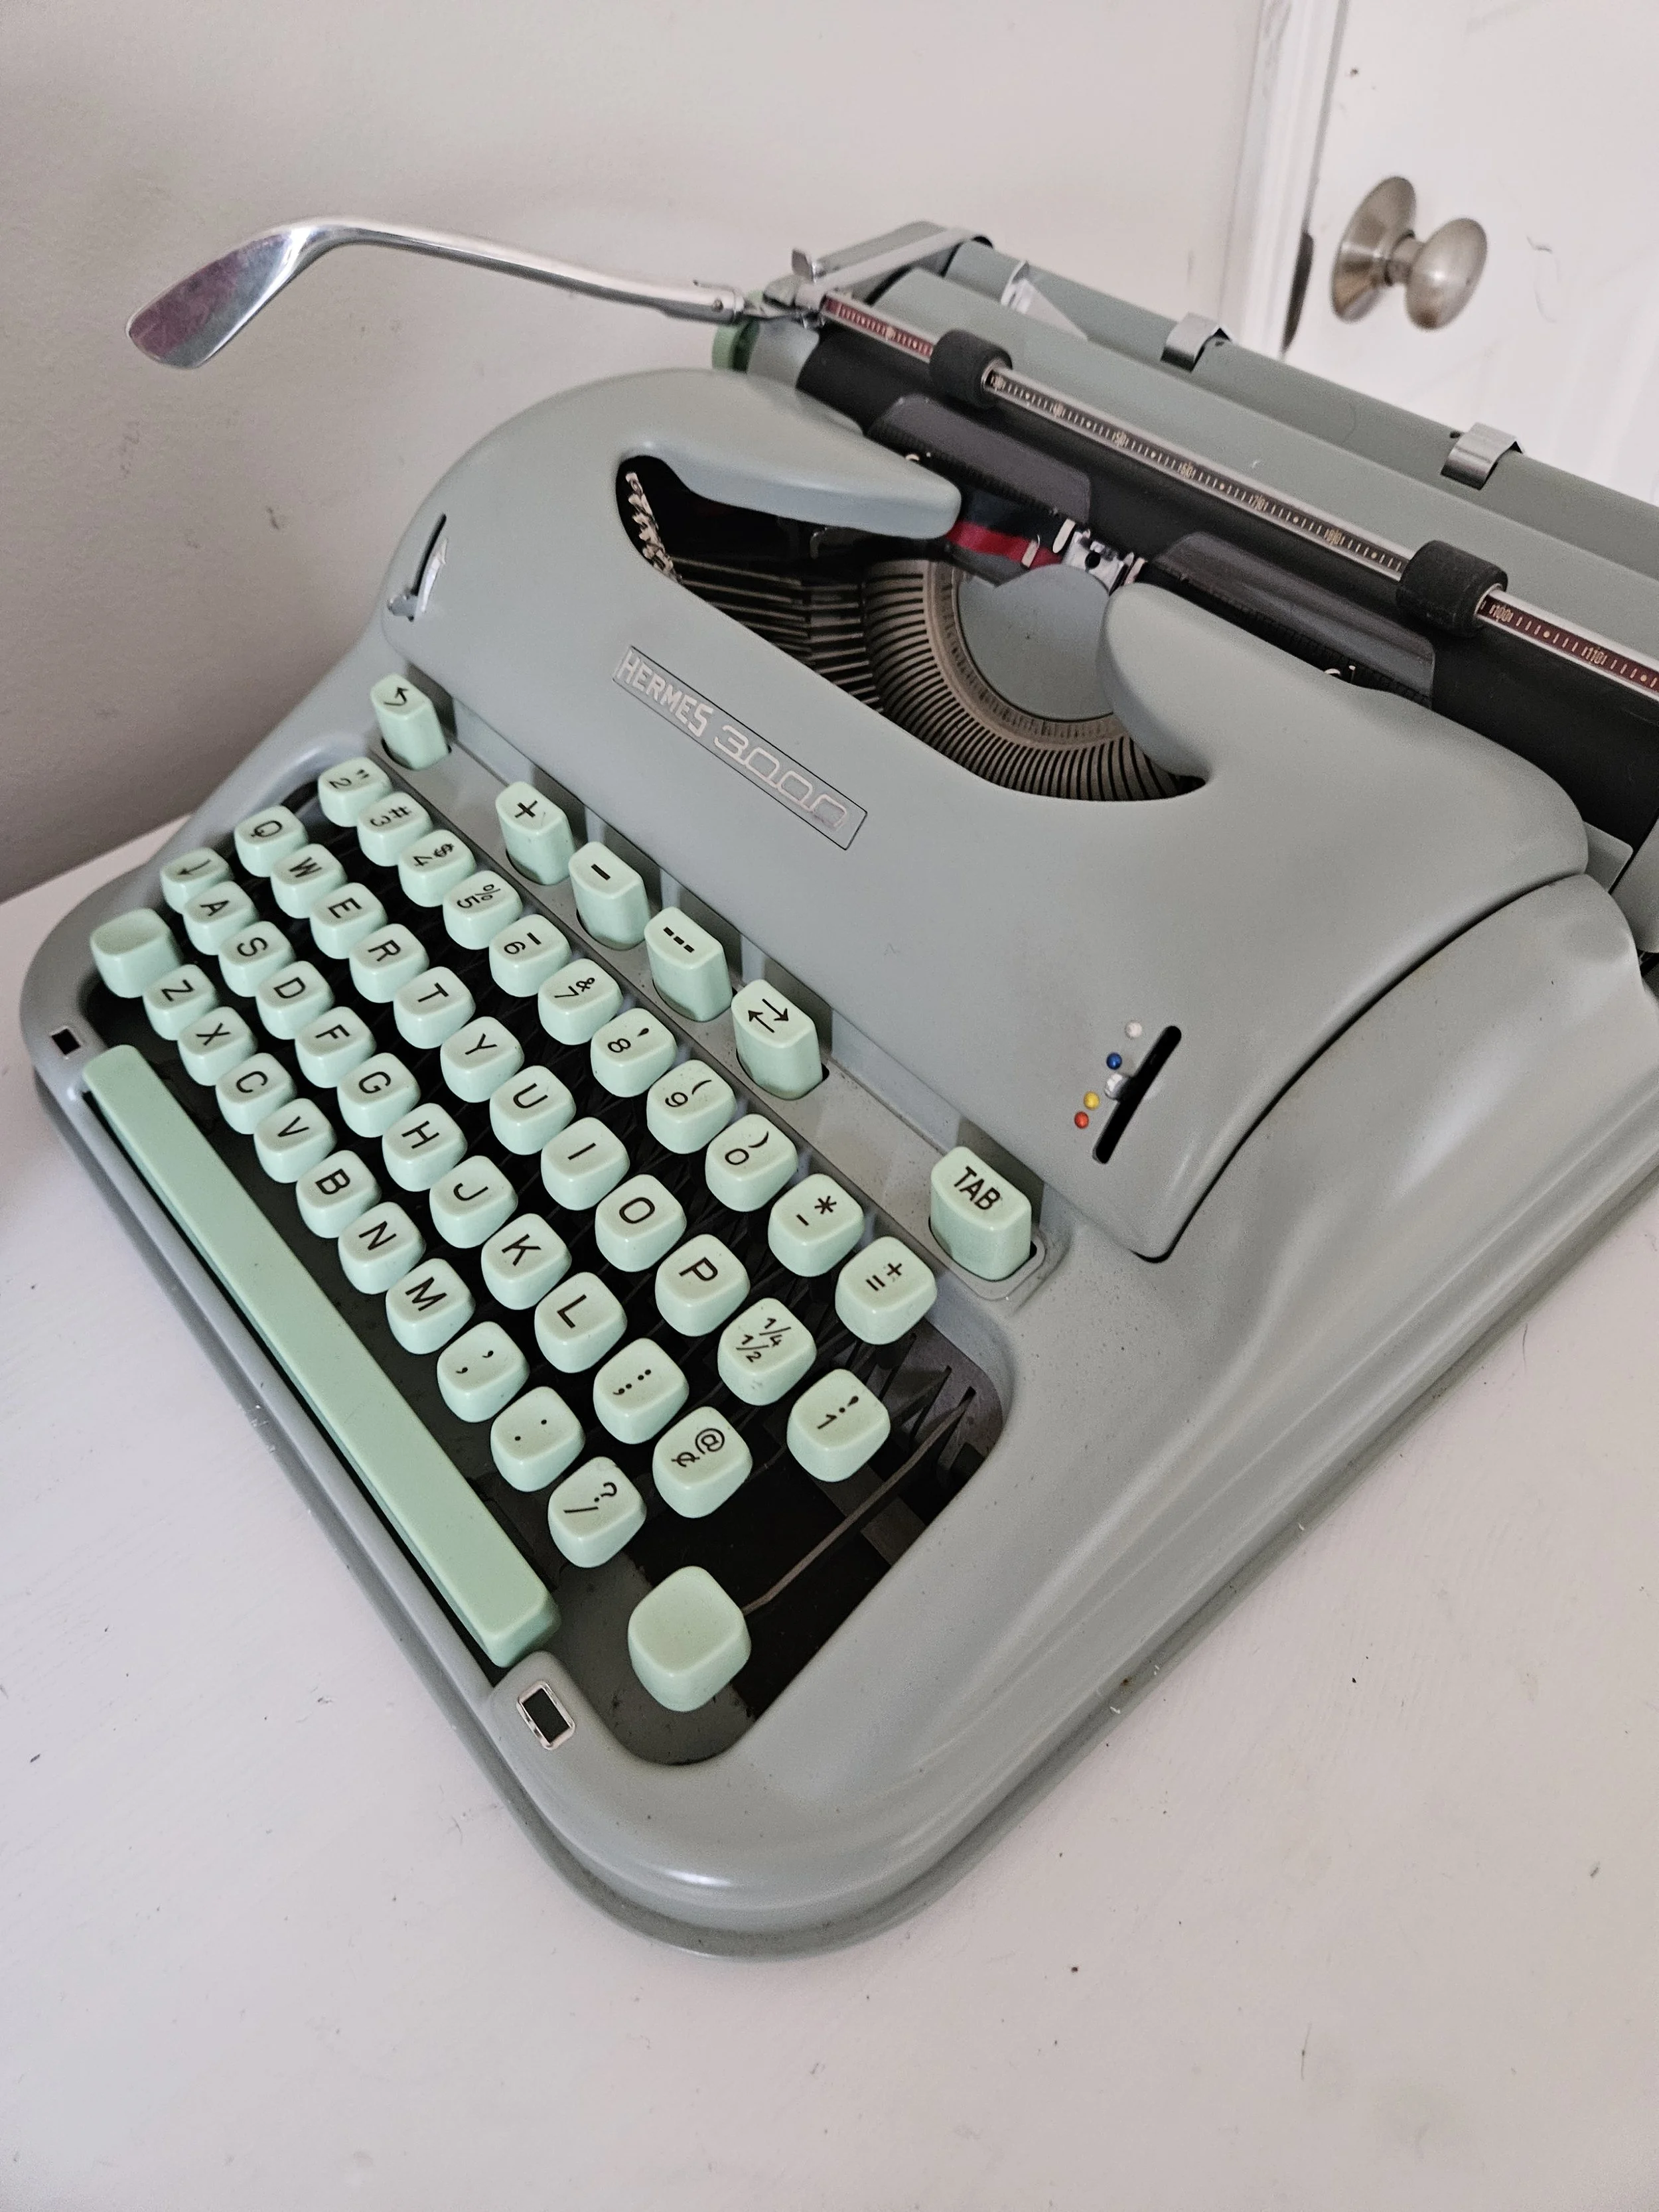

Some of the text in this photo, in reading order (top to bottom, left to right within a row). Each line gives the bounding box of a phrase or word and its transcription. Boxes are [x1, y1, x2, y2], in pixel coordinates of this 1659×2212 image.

[616, 650, 847, 828] HERMES 3000
[328, 778, 352, 789] 2
[250, 820, 283, 838] Q
[370, 813, 390, 827] 3
[413, 855, 433, 867] 4
[433, 843, 454, 857] $
[289, 857, 323, 879] W
[456, 894, 479, 909] 5
[481, 884, 501, 901] %
[199, 900, 230, 917] A
[327, 897, 362, 919] E
[236, 937, 269, 957] S
[367, 939, 401, 962] R
[504, 941, 526, 955] 6
[161, 979, 194, 1002] Z
[273, 976, 307, 999] D
[417, 982, 449, 1003] T
[554, 986, 578, 999] 7
[577, 977, 595, 991] &
[196, 1022, 231, 1047] X
[315, 1024, 350, 1039] F
[465, 1033, 498, 1056] Y
[607, 1038, 632, 1053] 8
[236, 1070, 268, 1094] C
[358, 1071, 392, 1094] G
[512, 1082, 549, 1109] U
[664, 1092, 689, 1108] 9
[277, 1116, 310, 1138] V
[401, 1120, 440, 1149] H
[315, 1168, 351, 1195] B
[453, 1183, 489, 1202] J
[954, 1166, 1001, 1210] TAB
[618, 1197, 656, 1224] O
[358, 1220, 397, 1251] N
[501, 1233, 541, 1267] K
[678, 1256, 719, 1282] P
[405, 1276, 448, 1312] M
[556, 1294, 587, 1329] L
[694, 1428, 725, 1455] @
[593, 1481, 618, 1503] ?
